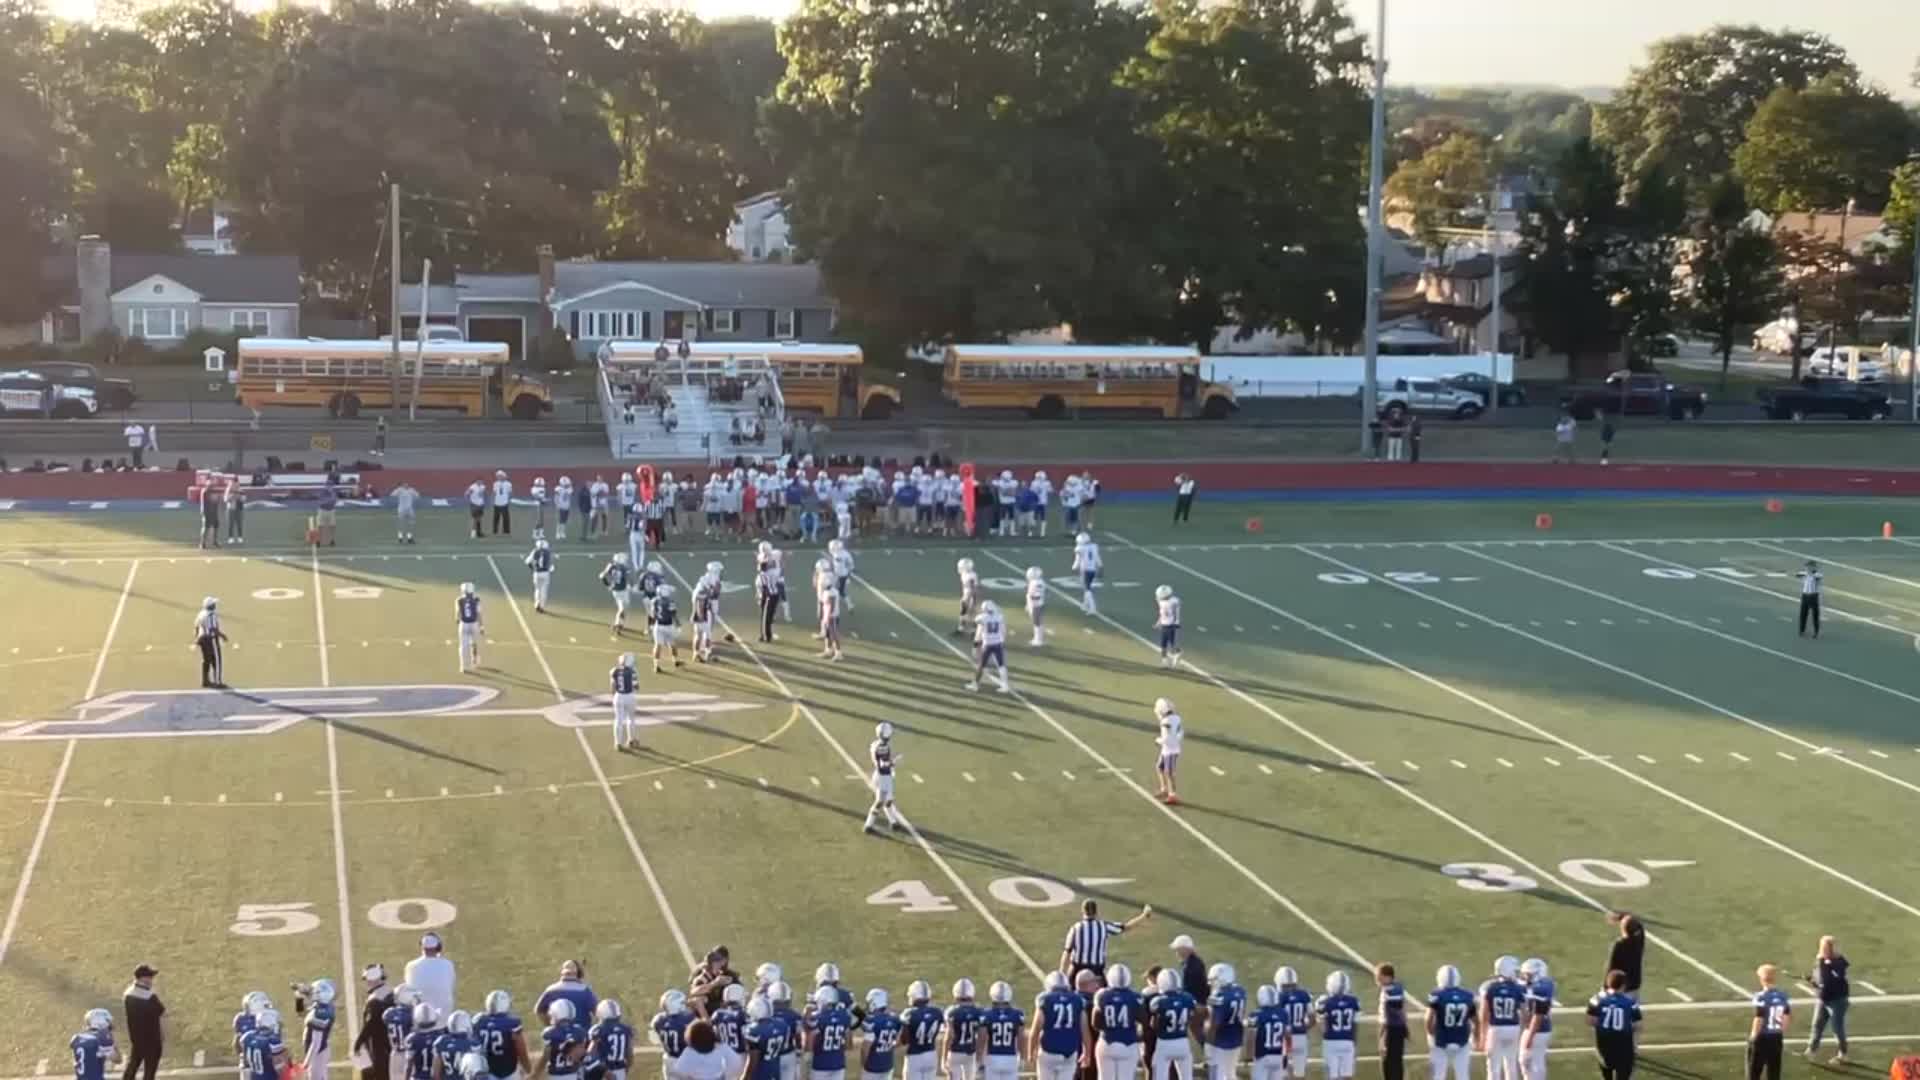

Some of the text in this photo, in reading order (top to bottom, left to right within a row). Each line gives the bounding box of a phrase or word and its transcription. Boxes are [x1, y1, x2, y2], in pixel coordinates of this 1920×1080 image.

[1053, 1003, 1073, 1029] 71
[1104, 1004, 1129, 1029] 84
[1165, 1007, 1188, 1033] 34
[1331, 1009, 1353, 1031] 33
[1443, 1003, 1468, 1027] 67
[1493, 997, 1515, 1019] 60
[1602, 1007, 1624, 1031] 70
[479, 1030, 503, 1055] 72
[823, 1025, 845, 1051] 65
[915, 1020, 939, 1045] 44
[992, 1021, 1014, 1047] 26
[1264, 1021, 1284, 1048] 12
[607, 1033, 625, 1061] 31
